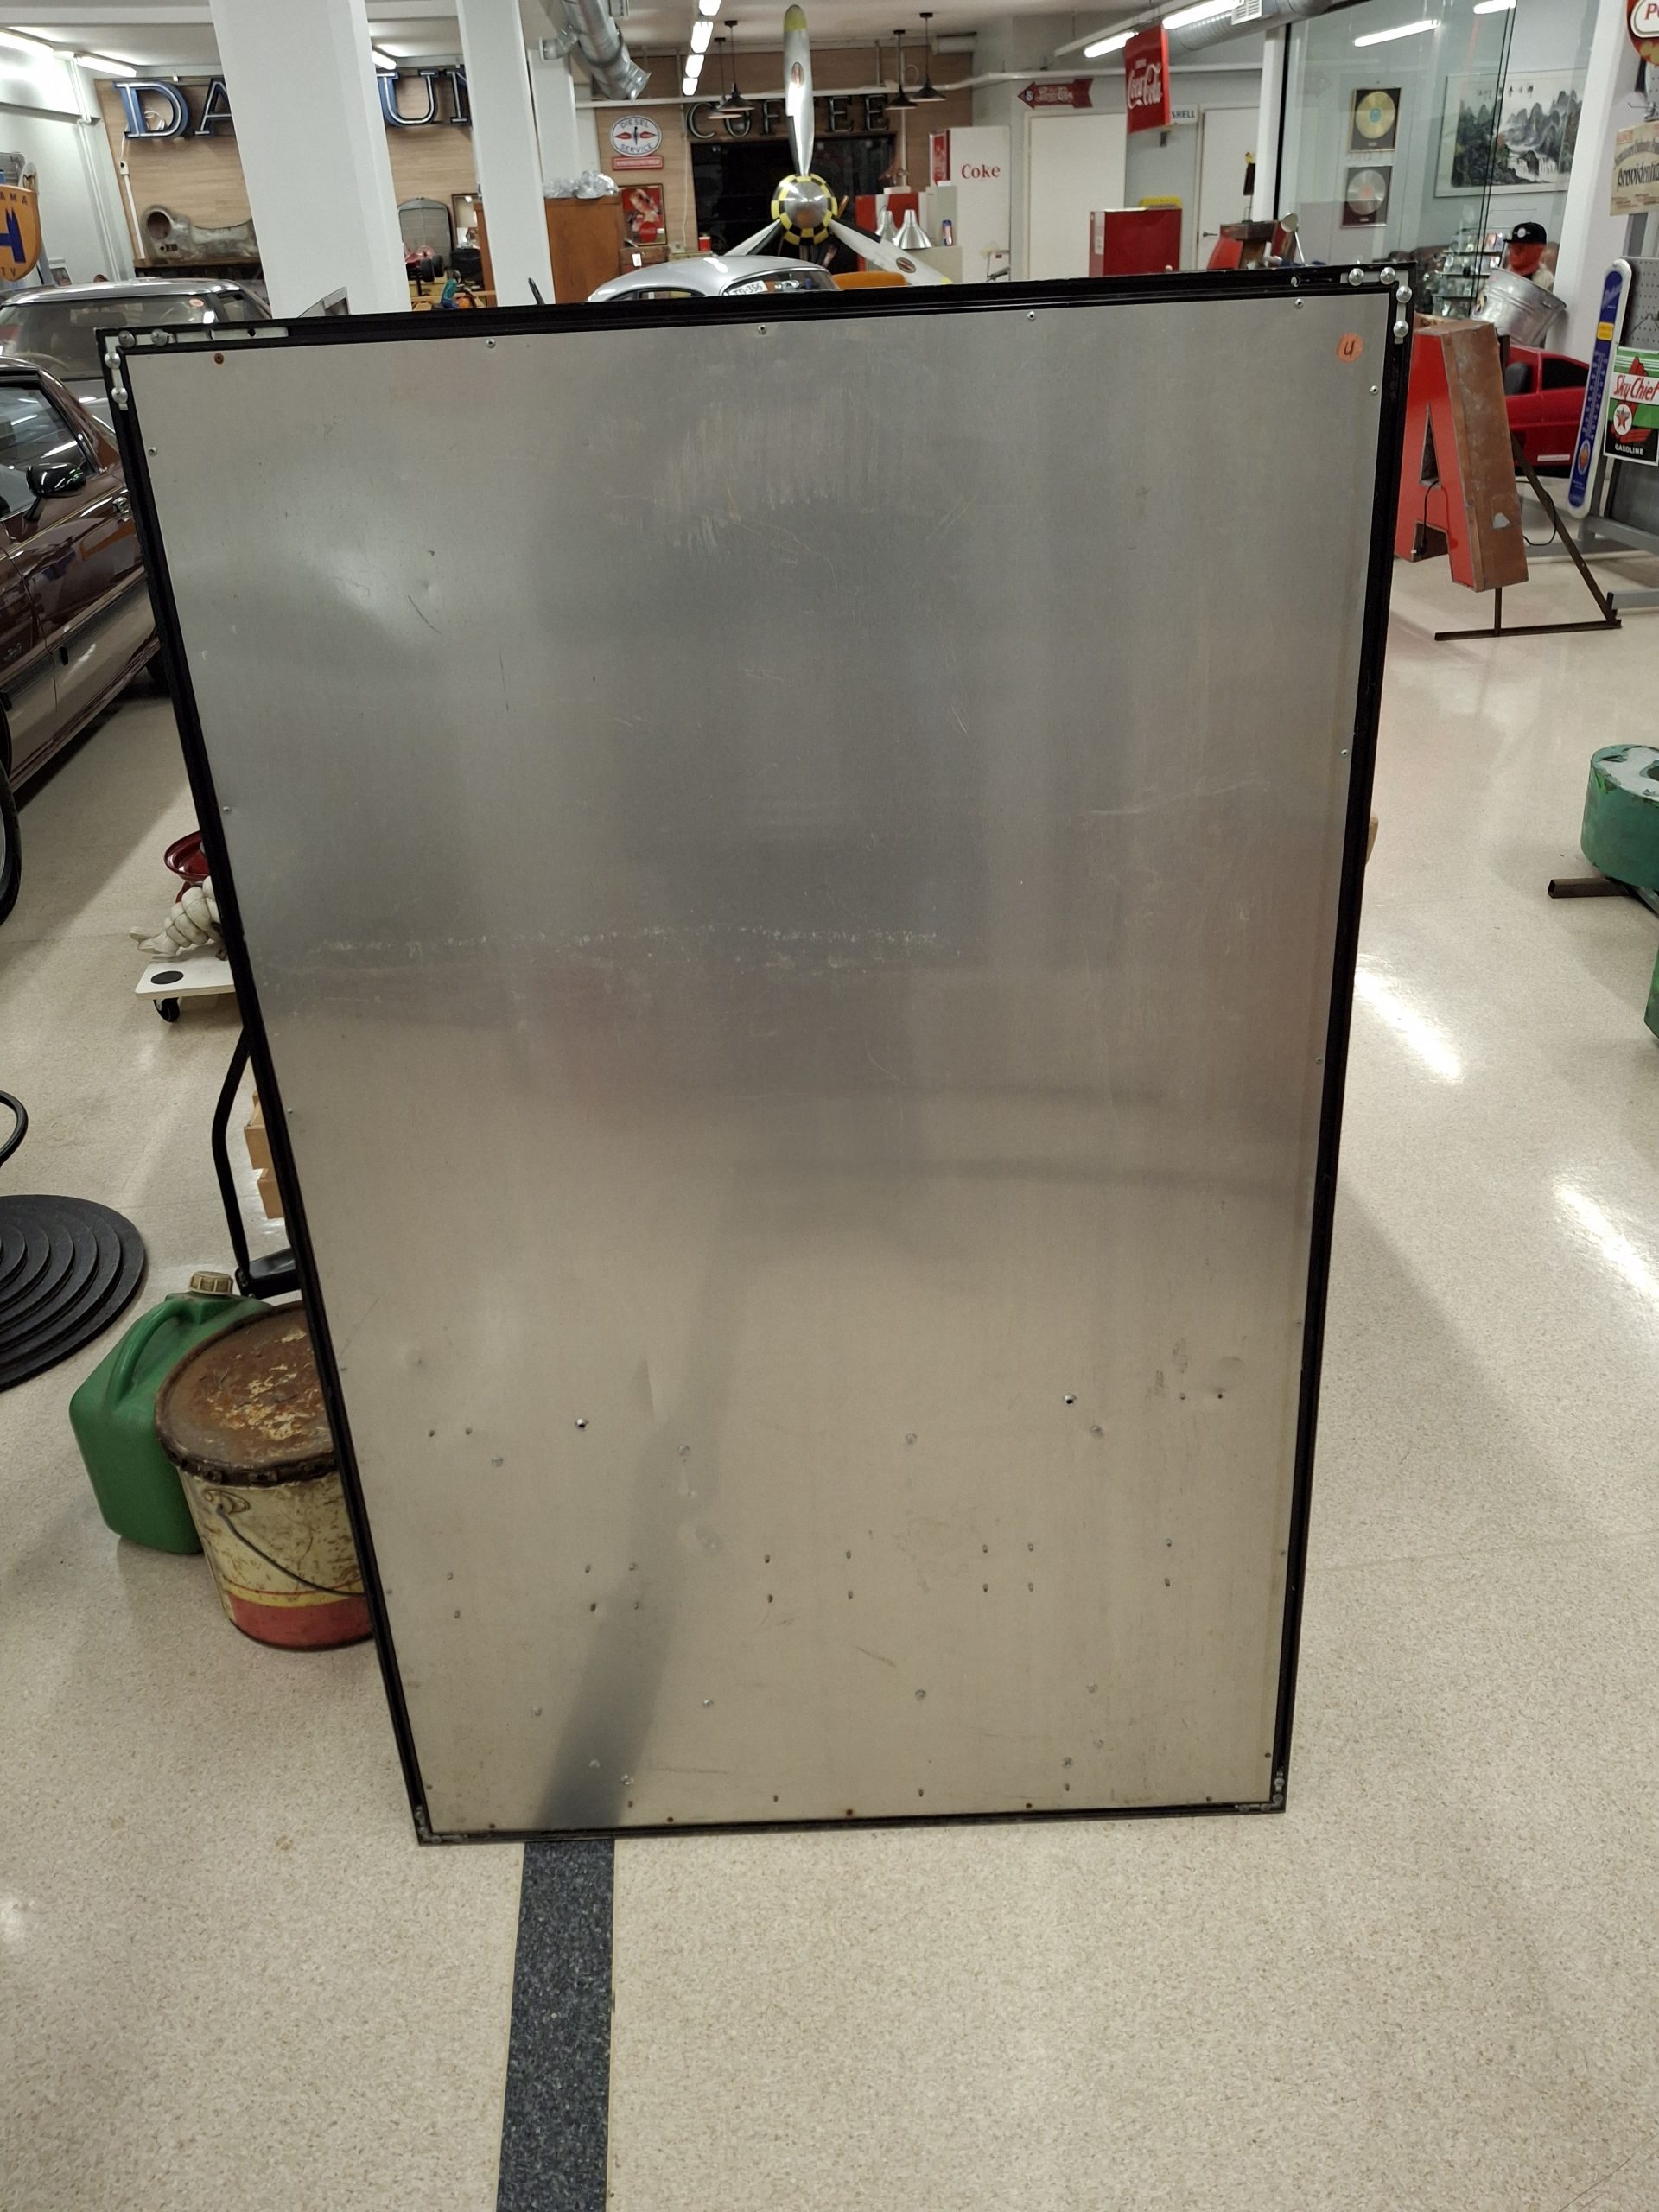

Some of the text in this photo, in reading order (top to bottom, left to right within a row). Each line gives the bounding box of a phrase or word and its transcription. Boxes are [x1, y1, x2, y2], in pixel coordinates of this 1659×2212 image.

[961, 163, 1001, 180] Coke
[1614, 374, 1631, 401] Sky
[1614, 443, 1643, 456] GASOLINE
